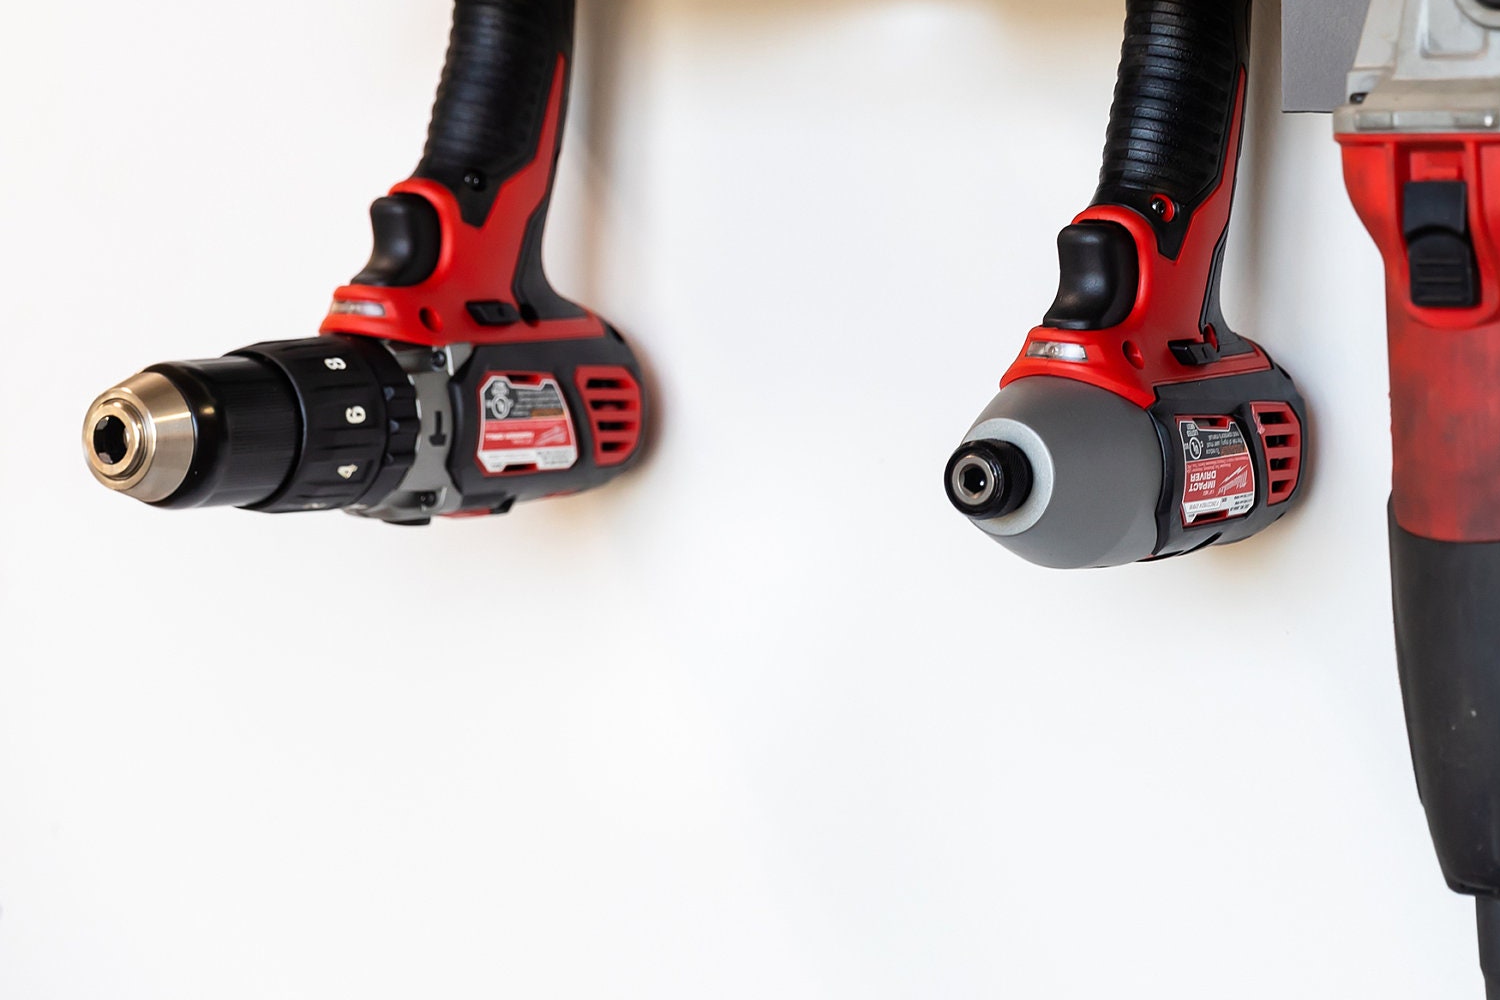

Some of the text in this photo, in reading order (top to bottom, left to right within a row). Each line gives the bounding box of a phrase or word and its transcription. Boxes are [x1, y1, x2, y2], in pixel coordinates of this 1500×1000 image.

[324, 357, 347, 371] 8
[1190, 470, 1217, 482] DRIVER
[1188, 479, 1217, 492] IMPACT
